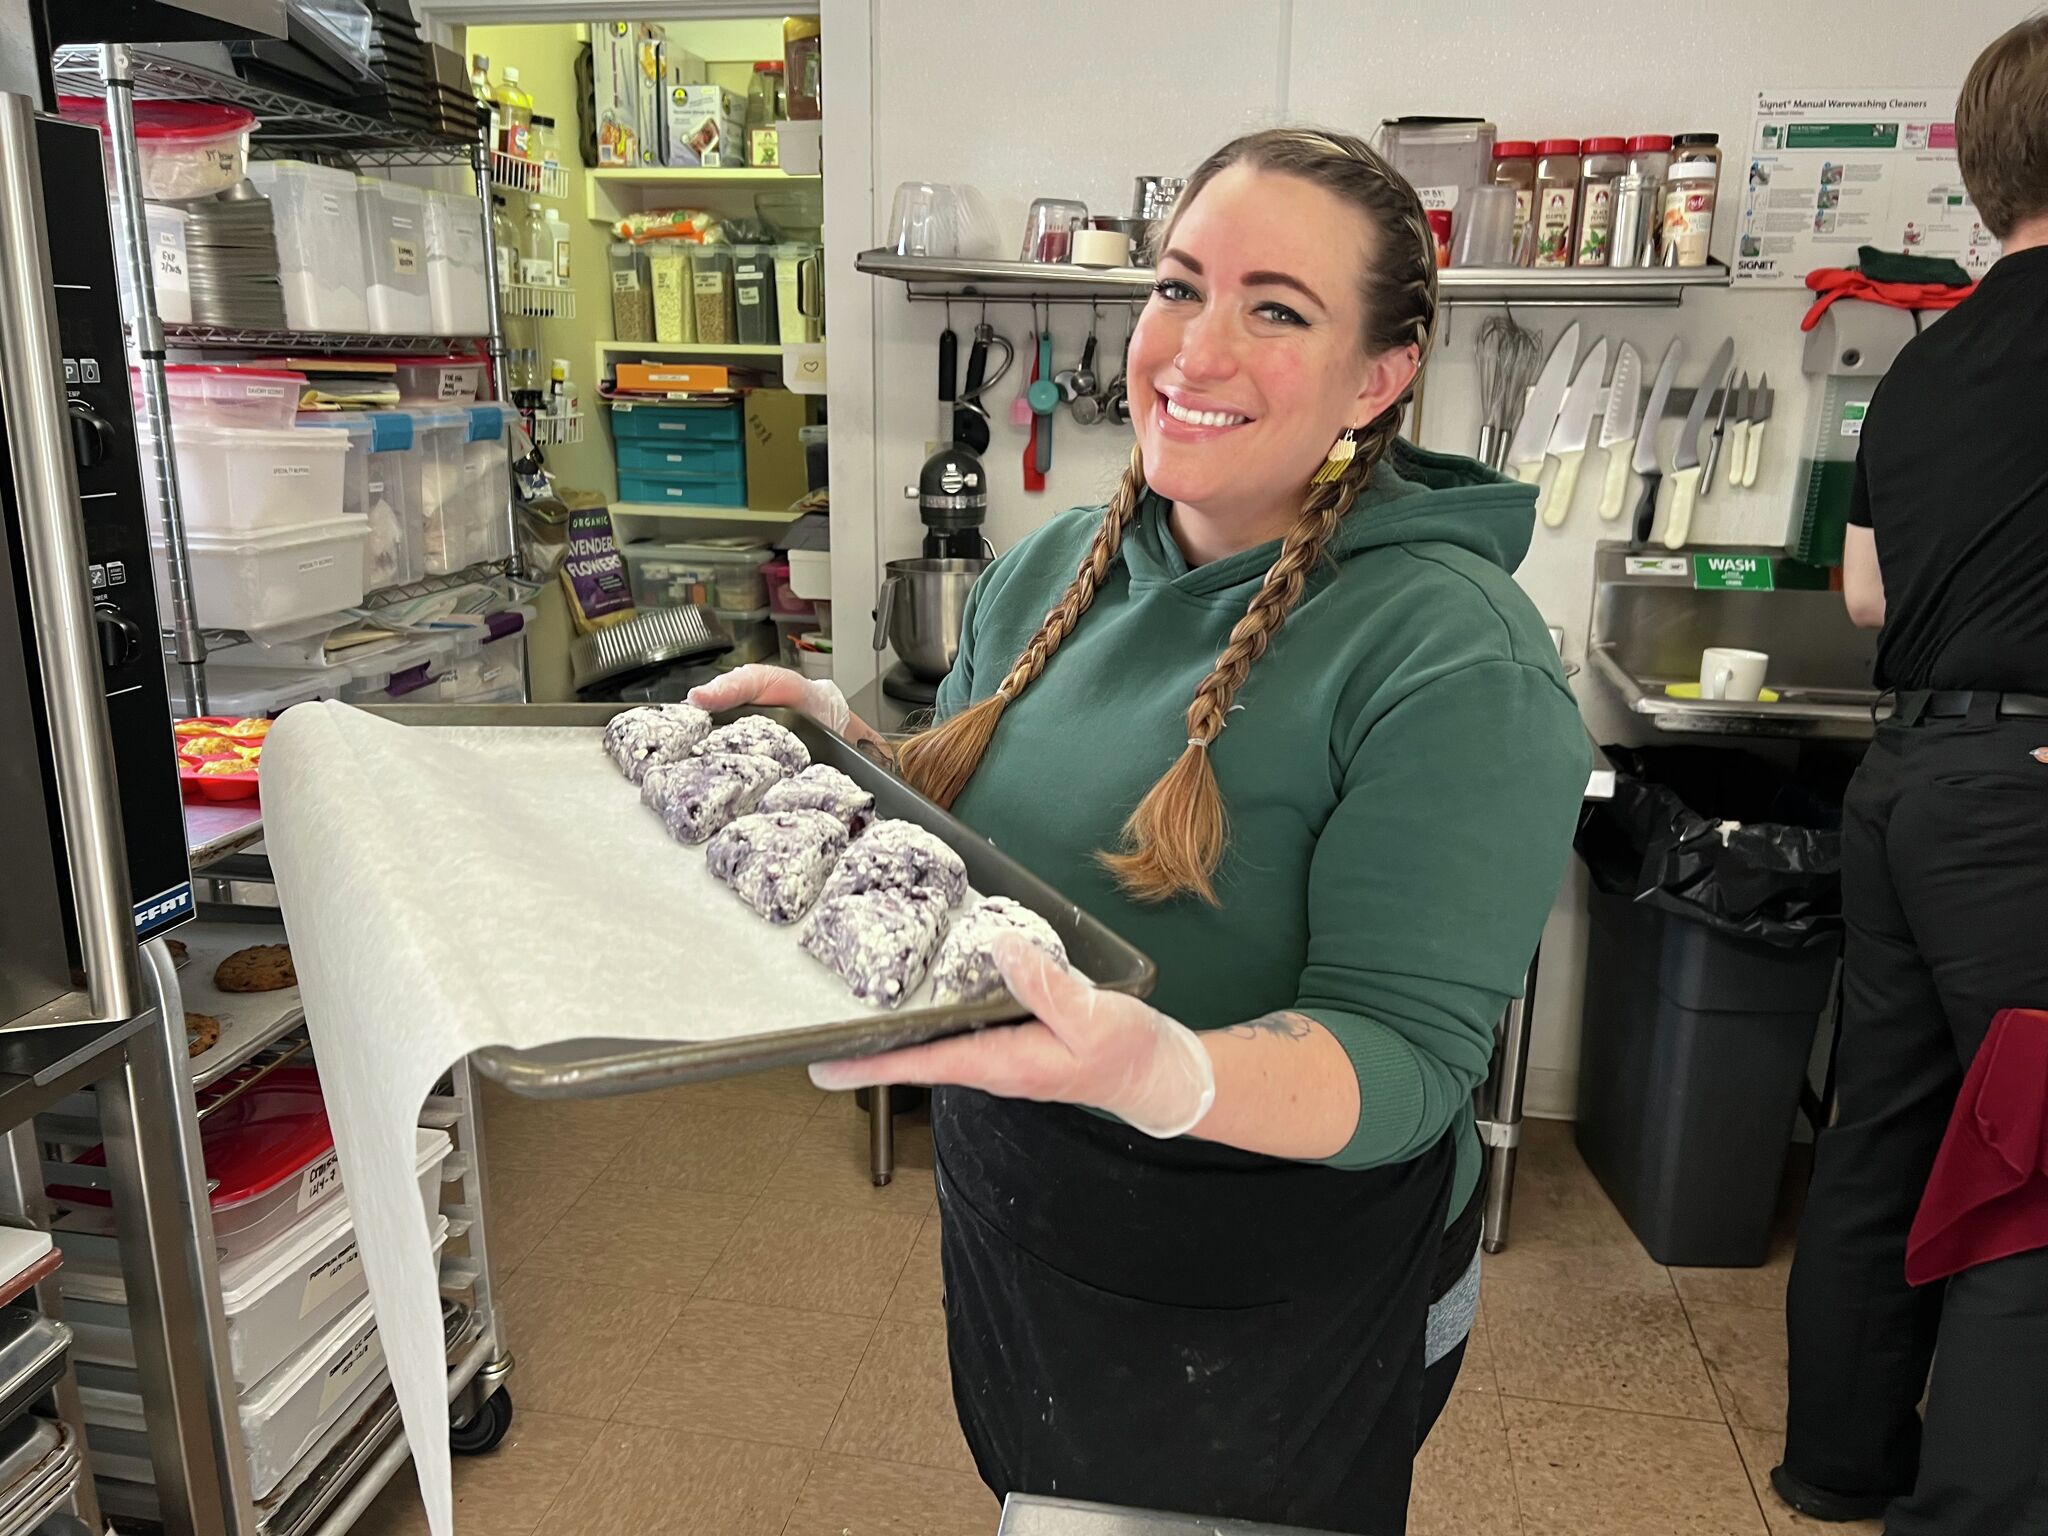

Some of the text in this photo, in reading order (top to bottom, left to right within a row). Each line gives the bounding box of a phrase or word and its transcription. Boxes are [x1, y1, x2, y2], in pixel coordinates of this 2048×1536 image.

[1793, 99, 1827, 108] Manual
[1828, 99, 1887, 110] Warewashing
[1888, 99, 1927, 109] Cleaners
[65, 365, 74, 379] P
[67, 390, 80, 398] EMP
[572, 516, 608, 529] ORGANIC
[568, 536, 616, 557] AVENDER
[567, 554, 622, 578] FLOWERS
[1708, 558, 1756, 572] WASH
